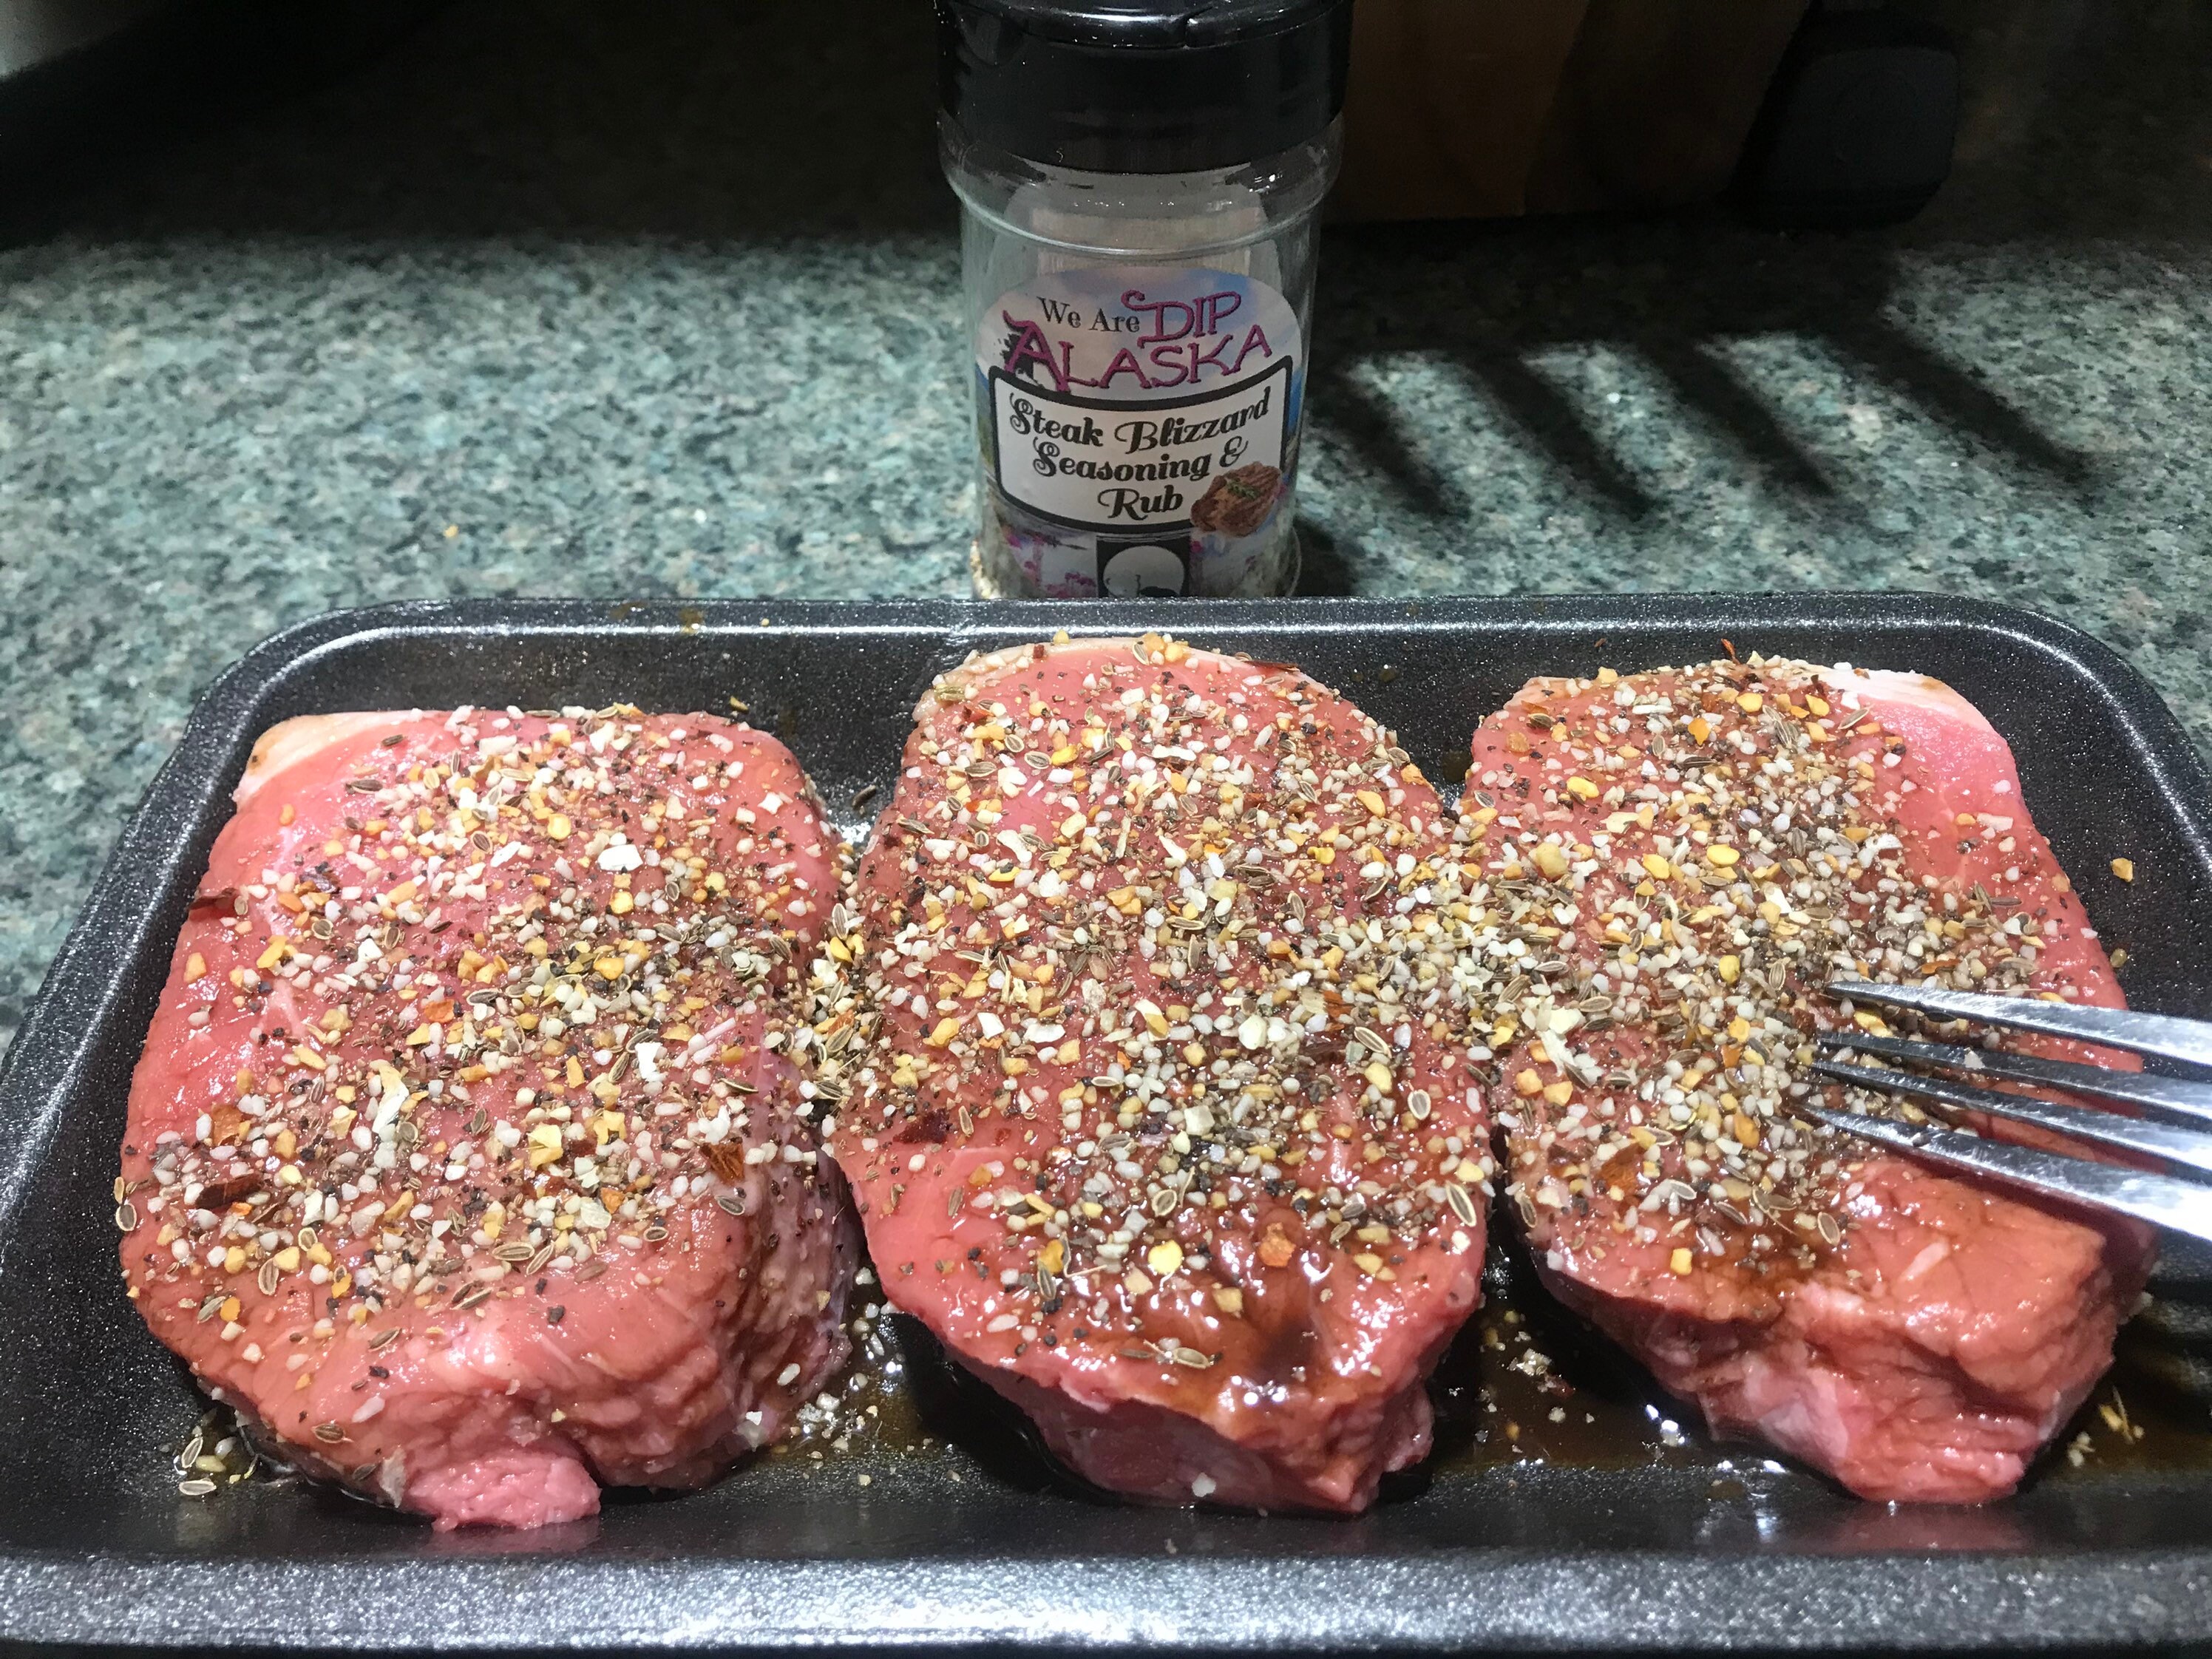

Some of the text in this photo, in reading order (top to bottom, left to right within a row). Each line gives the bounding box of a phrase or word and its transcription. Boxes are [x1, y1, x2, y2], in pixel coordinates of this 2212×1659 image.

[1037, 289, 1242, 348] We Are DIP
[1002, 309, 1273, 393] ALASKA
[1009, 386, 1271, 455] Steak Blizzard
[1032, 436, 1249, 482] Seasoning &
[1097, 484, 1184, 520] Rub
